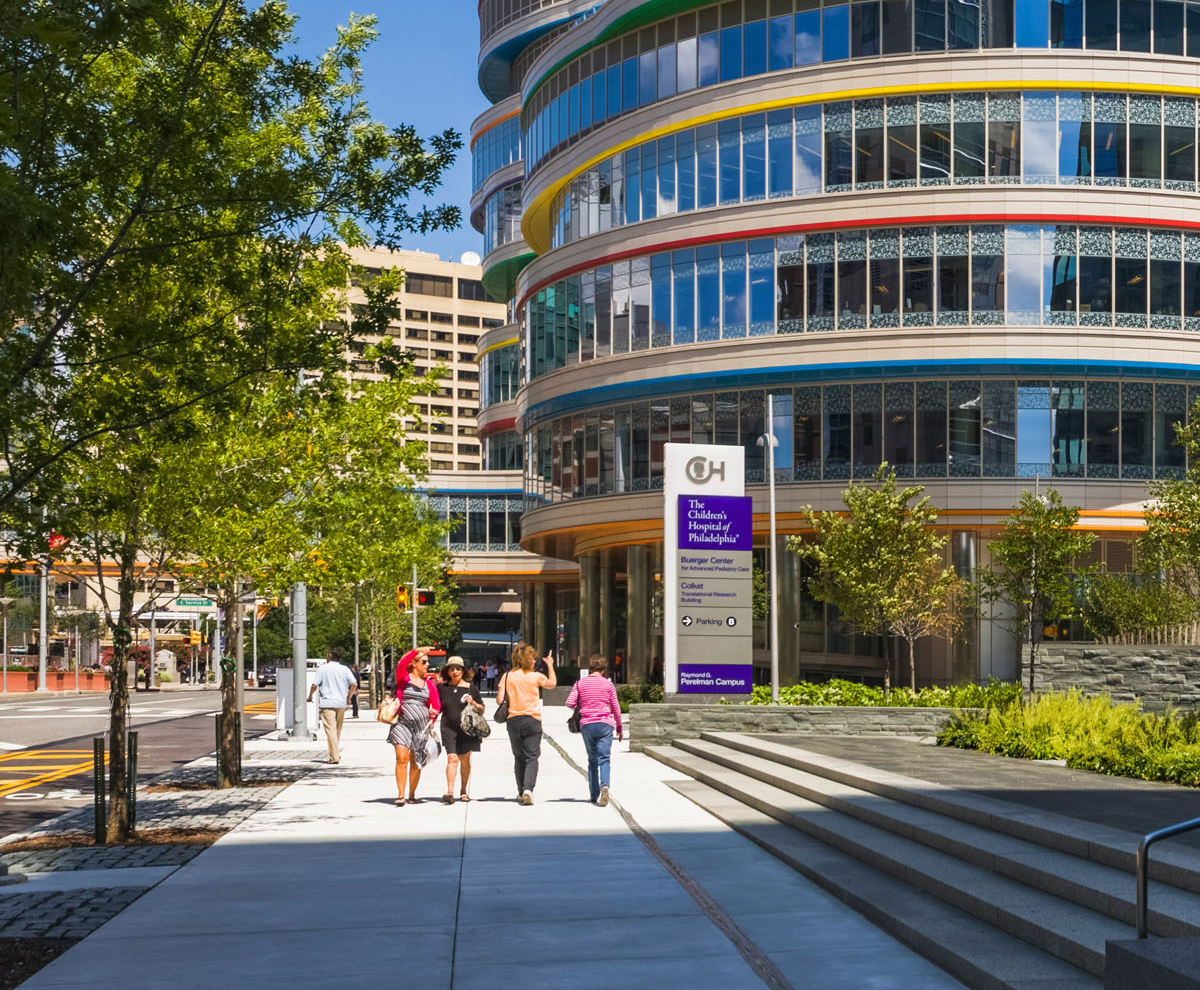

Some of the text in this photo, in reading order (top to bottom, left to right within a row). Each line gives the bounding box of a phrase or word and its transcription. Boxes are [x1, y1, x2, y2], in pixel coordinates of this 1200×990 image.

[688, 499, 704, 508] The
[688, 510, 727, 519] Children's
[688, 521, 732, 533] Hospital of
[681, 556, 708, 564] Buerger
[696, 617, 723, 626] Parking
[715, 678, 745, 686] Campus
